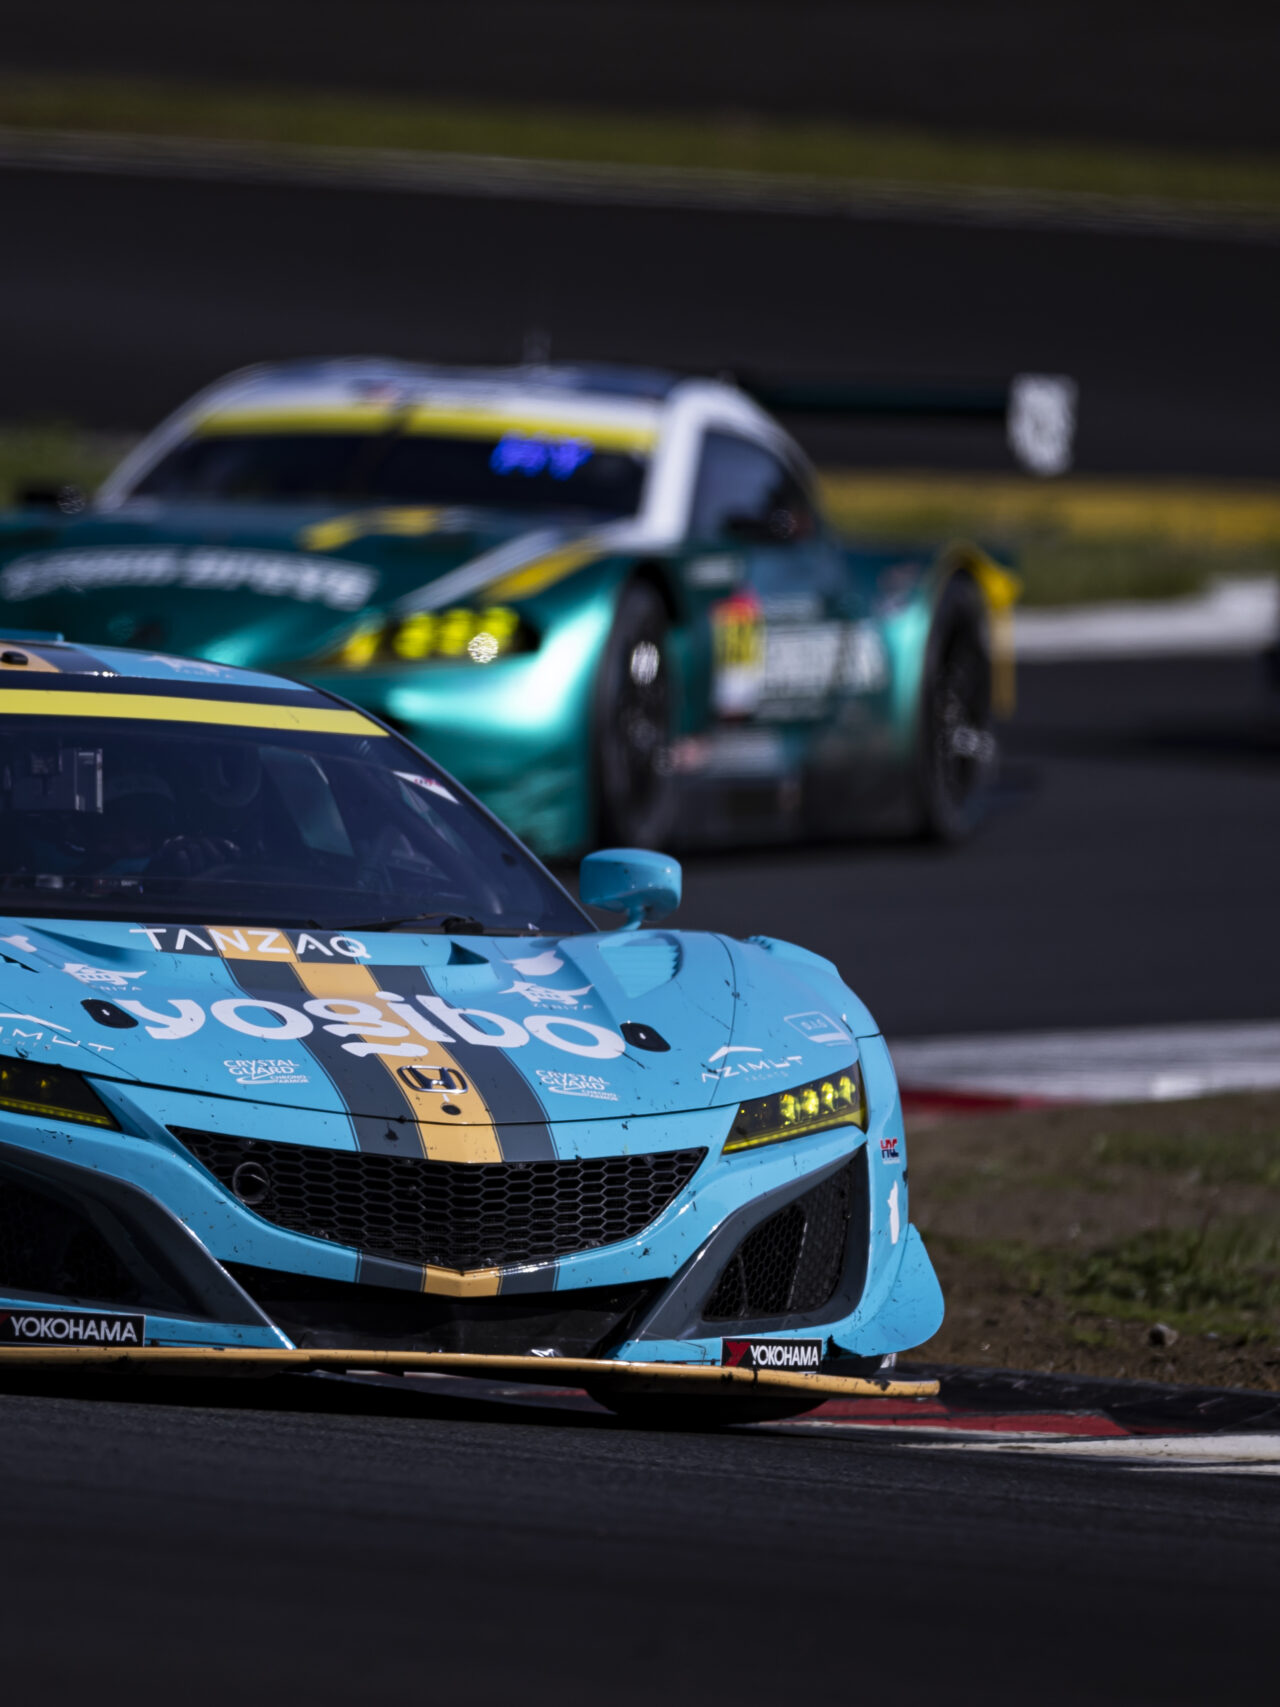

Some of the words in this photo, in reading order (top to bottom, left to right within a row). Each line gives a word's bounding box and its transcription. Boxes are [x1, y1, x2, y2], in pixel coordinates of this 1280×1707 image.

[128, 928, 372, 959] TANZAQ
[111, 990, 627, 1060] yogibo
[223, 1059, 301, 1069] CRYSTAL
[10, 1315, 139, 1343] YOKOHAMA
[750, 1344, 820, 1367] YOKOHAMA
